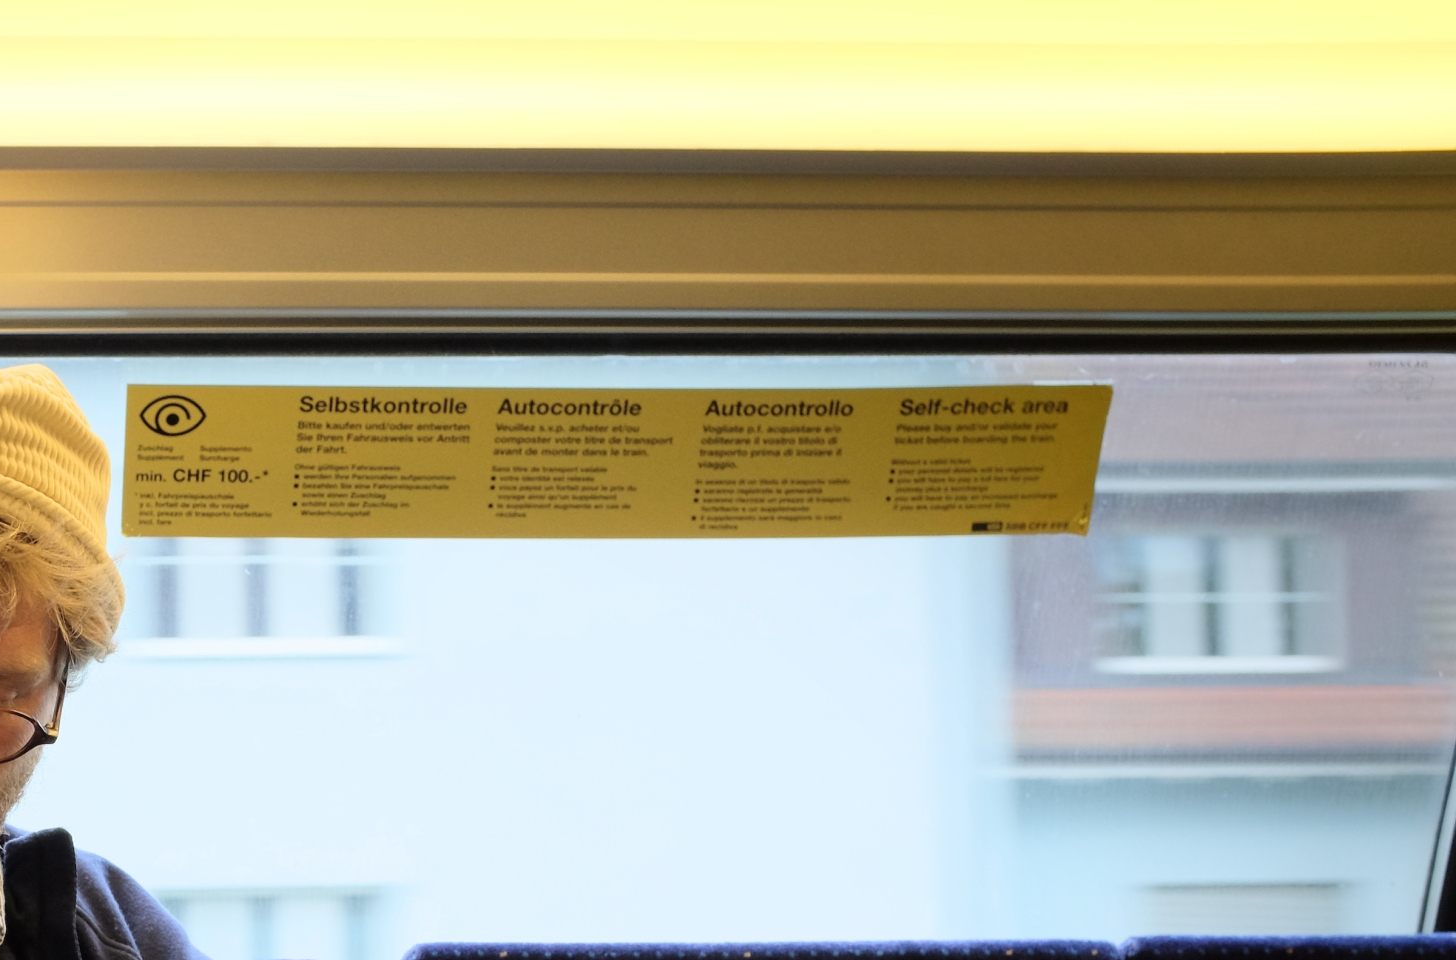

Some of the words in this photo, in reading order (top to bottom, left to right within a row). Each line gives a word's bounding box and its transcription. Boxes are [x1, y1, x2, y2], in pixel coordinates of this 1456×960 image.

[299, 396, 467, 414] Selbstkontrolle
[498, 398, 642, 416] Autocontrôle
[705, 400, 854, 417] Autocontrollo
[900, 398, 1014, 416] Self-check
[1022, 400, 1069, 414] area
[297, 421, 322, 430] Bitte
[326, 421, 362, 430] kaufen
[365, 422, 414, 431] und/oder
[416, 423, 470, 431] entwerten
[296, 433, 313, 442] Sie
[316, 433, 343, 442] Ihren
[347, 434, 414, 443] Fahrausweis
[436, 434, 470, 443] Antritt
[494, 437, 551, 445] composter
[555, 437, 581, 445] votre
[584, 436, 605, 445] titre
[608, 436, 621, 445] de
[625, 437, 673, 446] transport
[296, 445, 313, 454] der
[316, 445, 347, 454] Fahrt.
[493, 448, 522, 456] avant
[525, 448, 538, 456] de
[582, 448, 607, 456] dans
[610, 448, 619, 456] le
[622, 448, 648, 457] train.
[136, 471, 166, 482] min.
[173, 468, 211, 482] CHF
